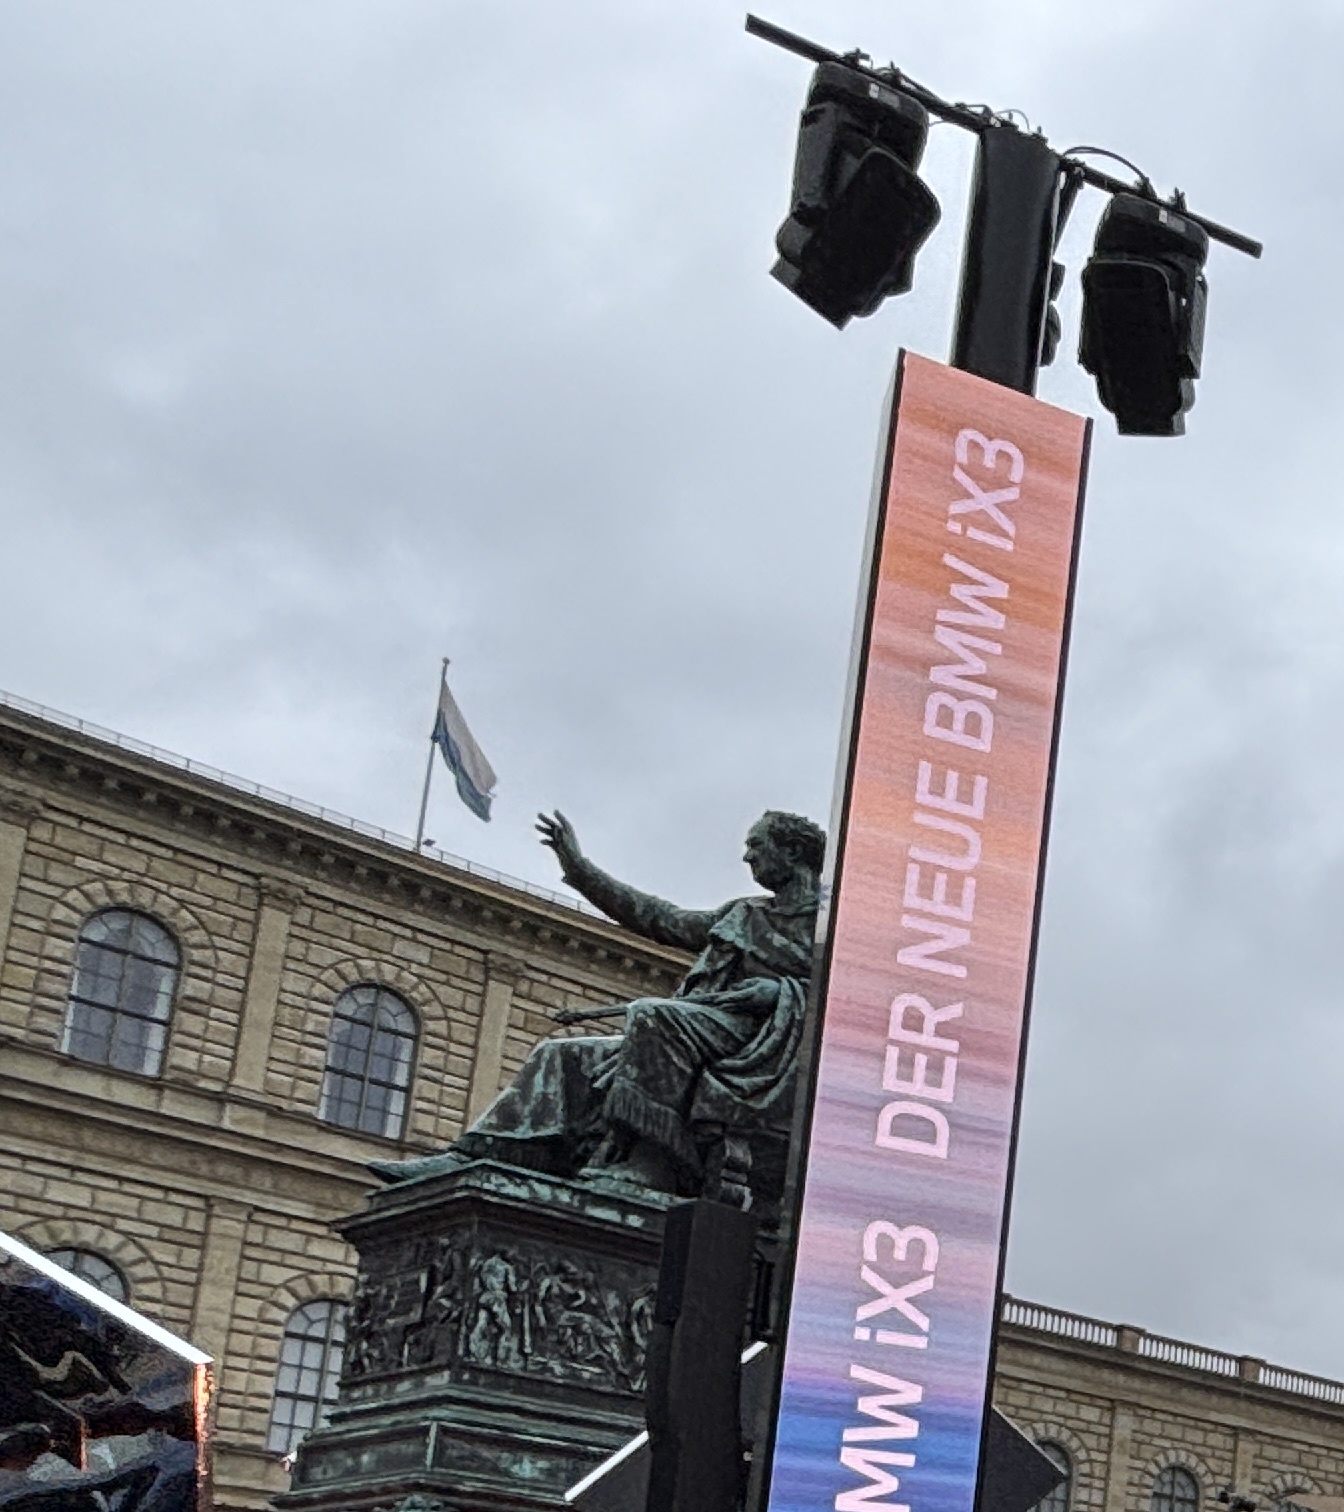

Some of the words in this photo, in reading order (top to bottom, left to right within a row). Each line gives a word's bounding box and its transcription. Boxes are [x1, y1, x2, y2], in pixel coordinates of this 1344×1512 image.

[946, 428, 1024, 552] iX3
[922, 553, 1010, 753] BMW
[897, 760, 989, 979] NEUE
[875, 992, 964, 1159] DER
[854, 1220, 940, 1349] iX3
